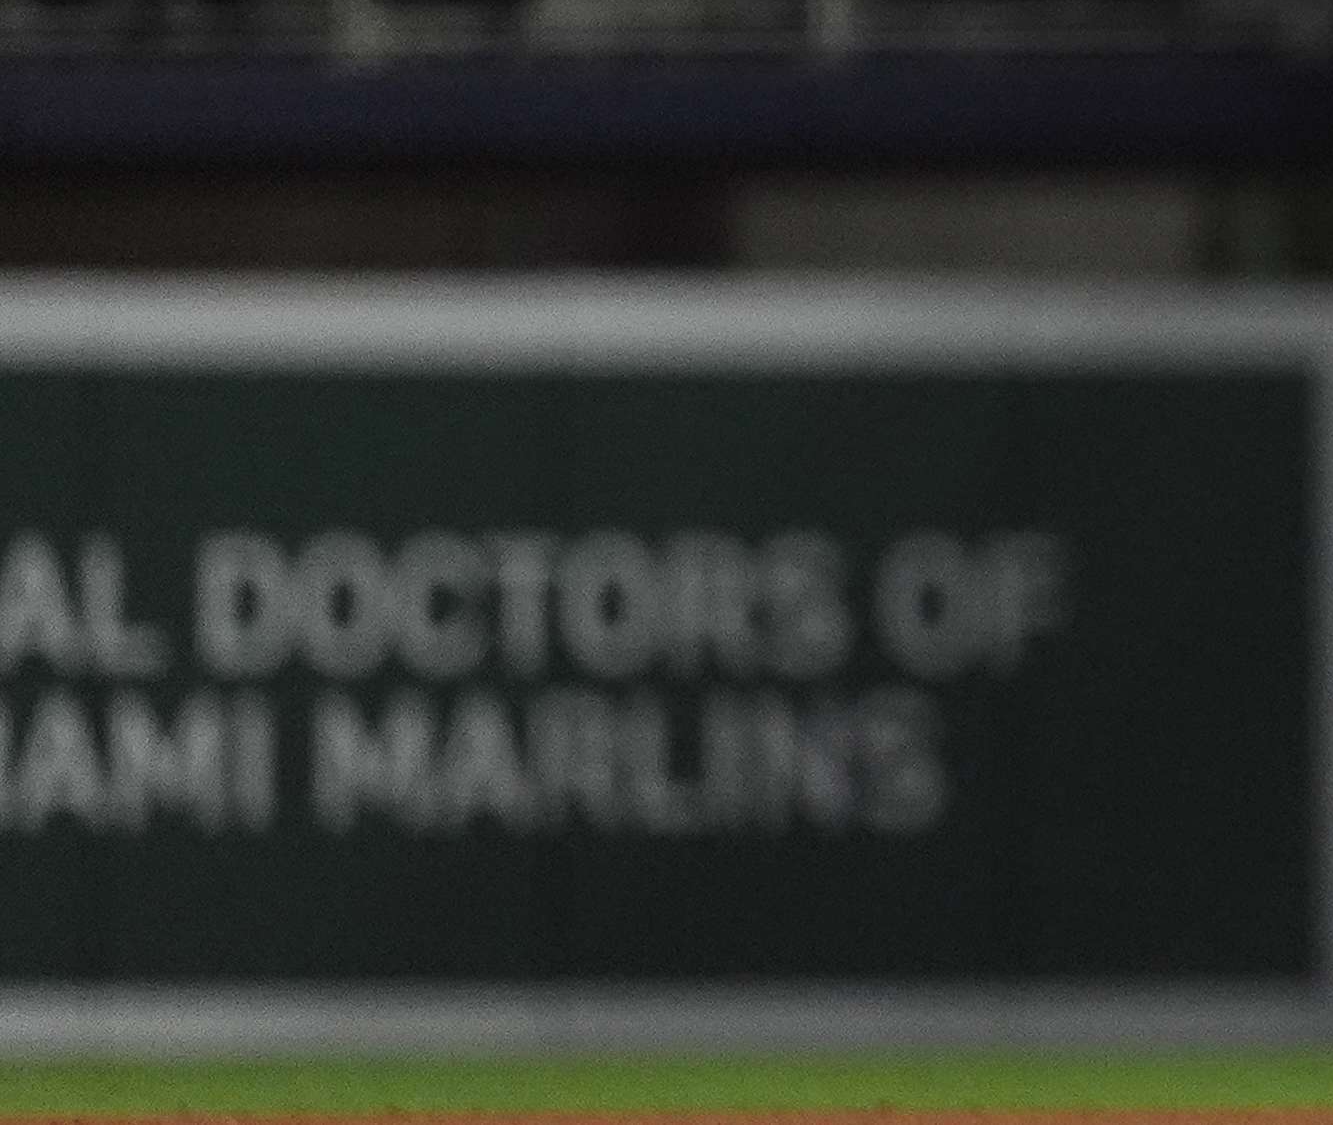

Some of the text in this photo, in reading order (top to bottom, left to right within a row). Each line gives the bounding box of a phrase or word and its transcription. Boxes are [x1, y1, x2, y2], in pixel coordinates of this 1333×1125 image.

[0, 528, 1070, 677] AL DOCTORS OF
[0, 687, 948, 833] AMI MARLINS
